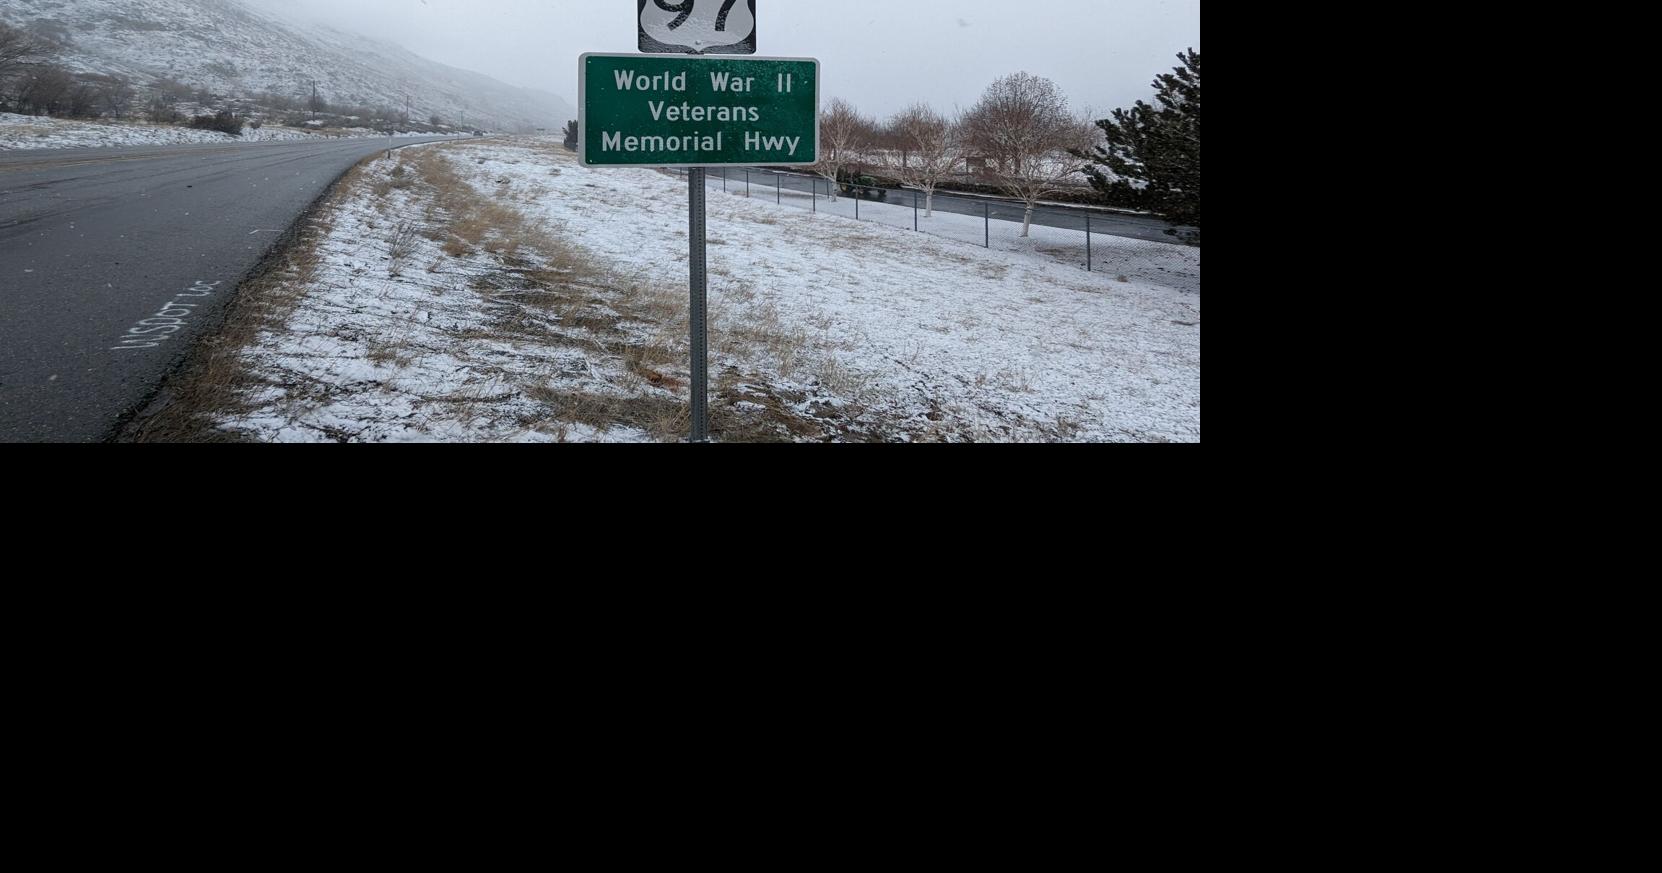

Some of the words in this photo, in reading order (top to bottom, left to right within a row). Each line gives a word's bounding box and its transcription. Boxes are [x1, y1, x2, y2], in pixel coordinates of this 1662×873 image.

[613, 69, 687, 92] World
[710, 71, 755, 93] War
[777, 73, 792, 93] II
[648, 100, 760, 122] Veterans
[601, 130, 722, 152] Memorial
[744, 131, 801, 156] Hwy
